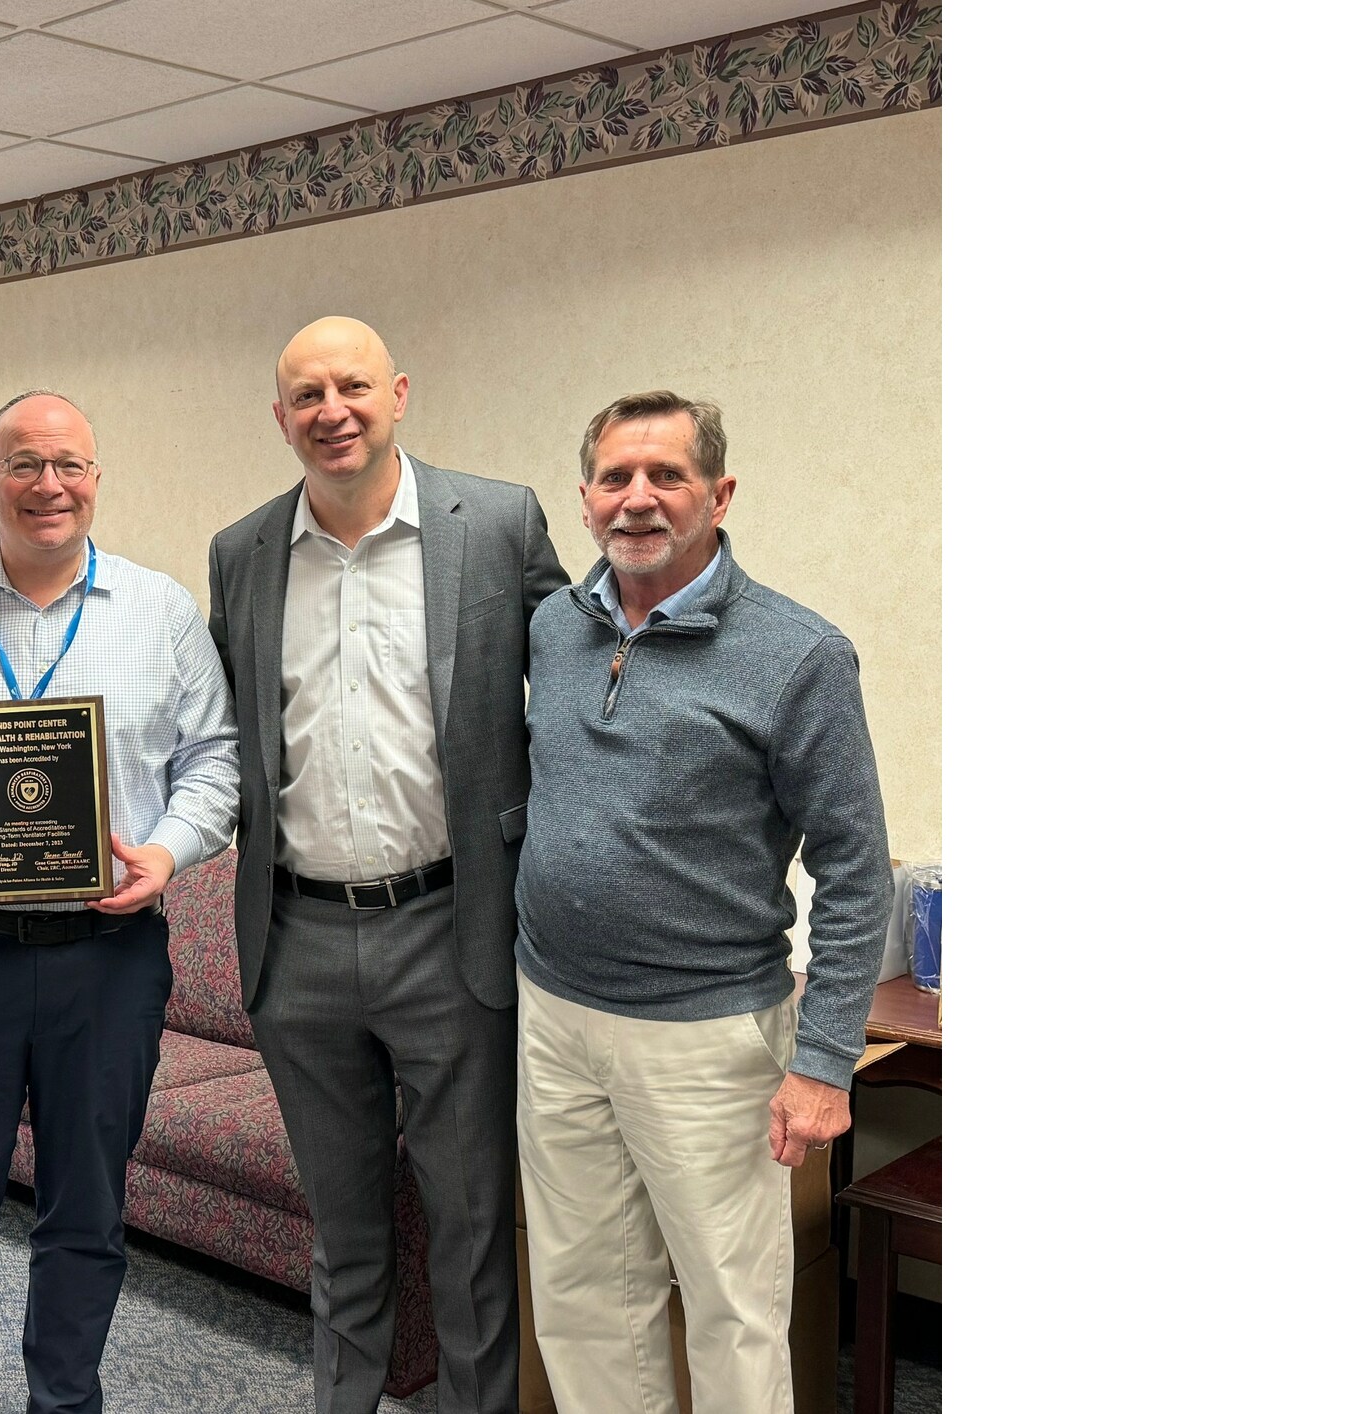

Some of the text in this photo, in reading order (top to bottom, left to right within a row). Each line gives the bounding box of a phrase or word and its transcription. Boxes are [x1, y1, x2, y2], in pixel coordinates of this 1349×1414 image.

[14, 721, 36, 729] POINT
[38, 719, 67, 728] CENTER
[25, 731, 85, 741] REHABILITATION
[21, 771, 47, 785] RESPIRATORY
